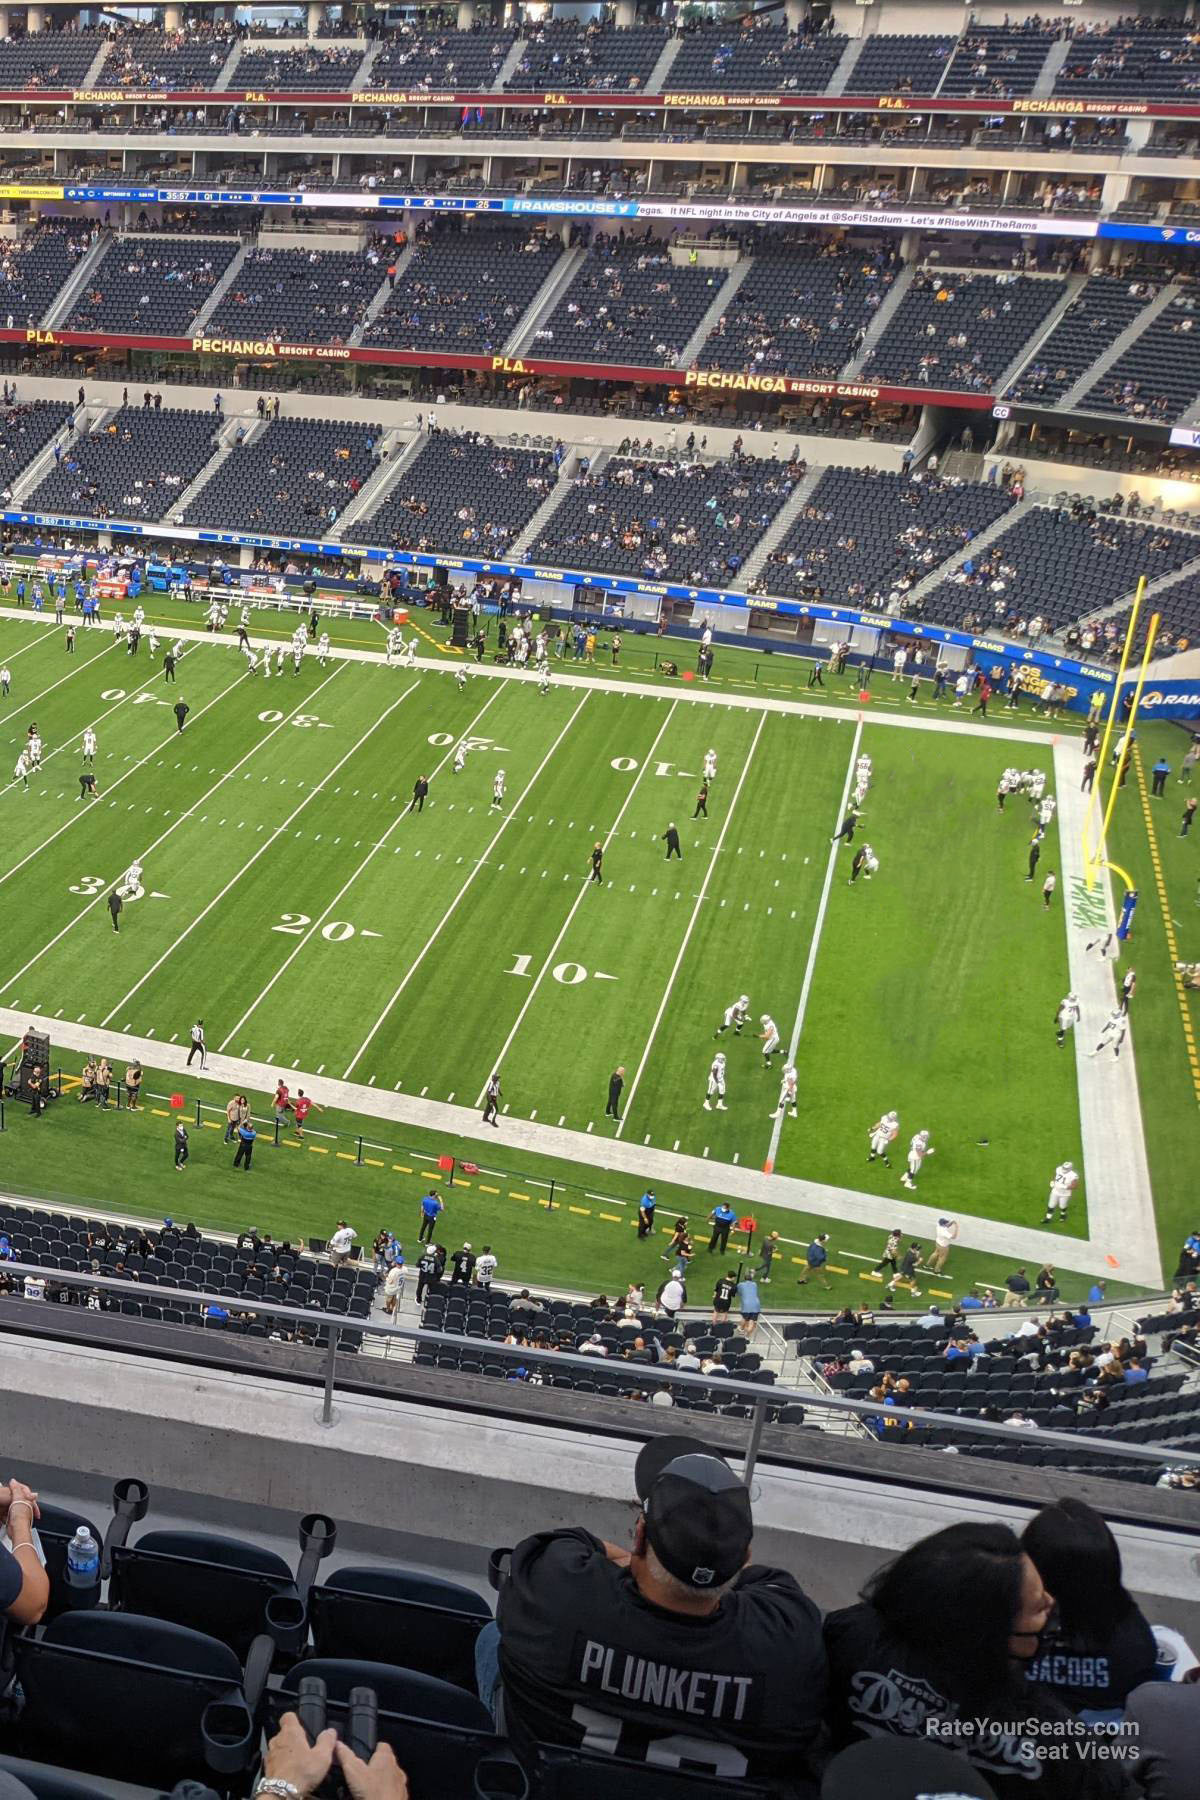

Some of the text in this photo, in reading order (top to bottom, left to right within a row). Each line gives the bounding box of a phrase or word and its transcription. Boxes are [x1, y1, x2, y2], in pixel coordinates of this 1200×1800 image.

[73, 92, 124, 101] PECHANGA
[352, 93, 406, 103] PECHANGA
[664, 95, 725, 106] PECHANGA
[1013, 100, 1084, 113] PECHANGA
[512, 201, 615, 213] #RAMSHOUSE
[679, 208, 697, 216] NFL
[699, 209, 723, 218] night
[725, 209, 732, 217] in
[734, 209, 749, 218] the
[752, 210, 771, 221] City
[773, 211, 783, 219] of
[785, 211, 818, 222] Angels
[820, 213, 829, 221] at
[831, 212, 902, 224] @SoFiStadium
[911, 215, 935, 225] Let's
[938, 216, 1038, 230] #RiseWithTheRams
[192, 338, 350, 358] PECHANGA RESORT CASINO
[685, 371, 879, 398] PECHANGA RESORT CASINO
[994, 408, 1008, 417] CC
[341, 547, 368, 557] RAMS
[435, 558, 463, 568] RAMS
[534, 570, 563, 580] RAMS
[637, 584, 667, 595] RAMS
[746, 599, 778, 610] RAMS
[860, 617, 892, 628] RAMS
[972, 639, 1004, 654] RAMS
[1080, 666, 1112, 682] RAMS
[271, 912, 355, 941] 20
[504, 953, 588, 985] 10
[1056, 1174, 1066, 1185] 71
[420, 1260, 436, 1274] 34
[481, 1265, 493, 1276] 32
[719, 1288, 729, 1300] 11
[1025, 1655, 1110, 1687] JACOBS
[579, 1640, 753, 1722] PLUNKETT
